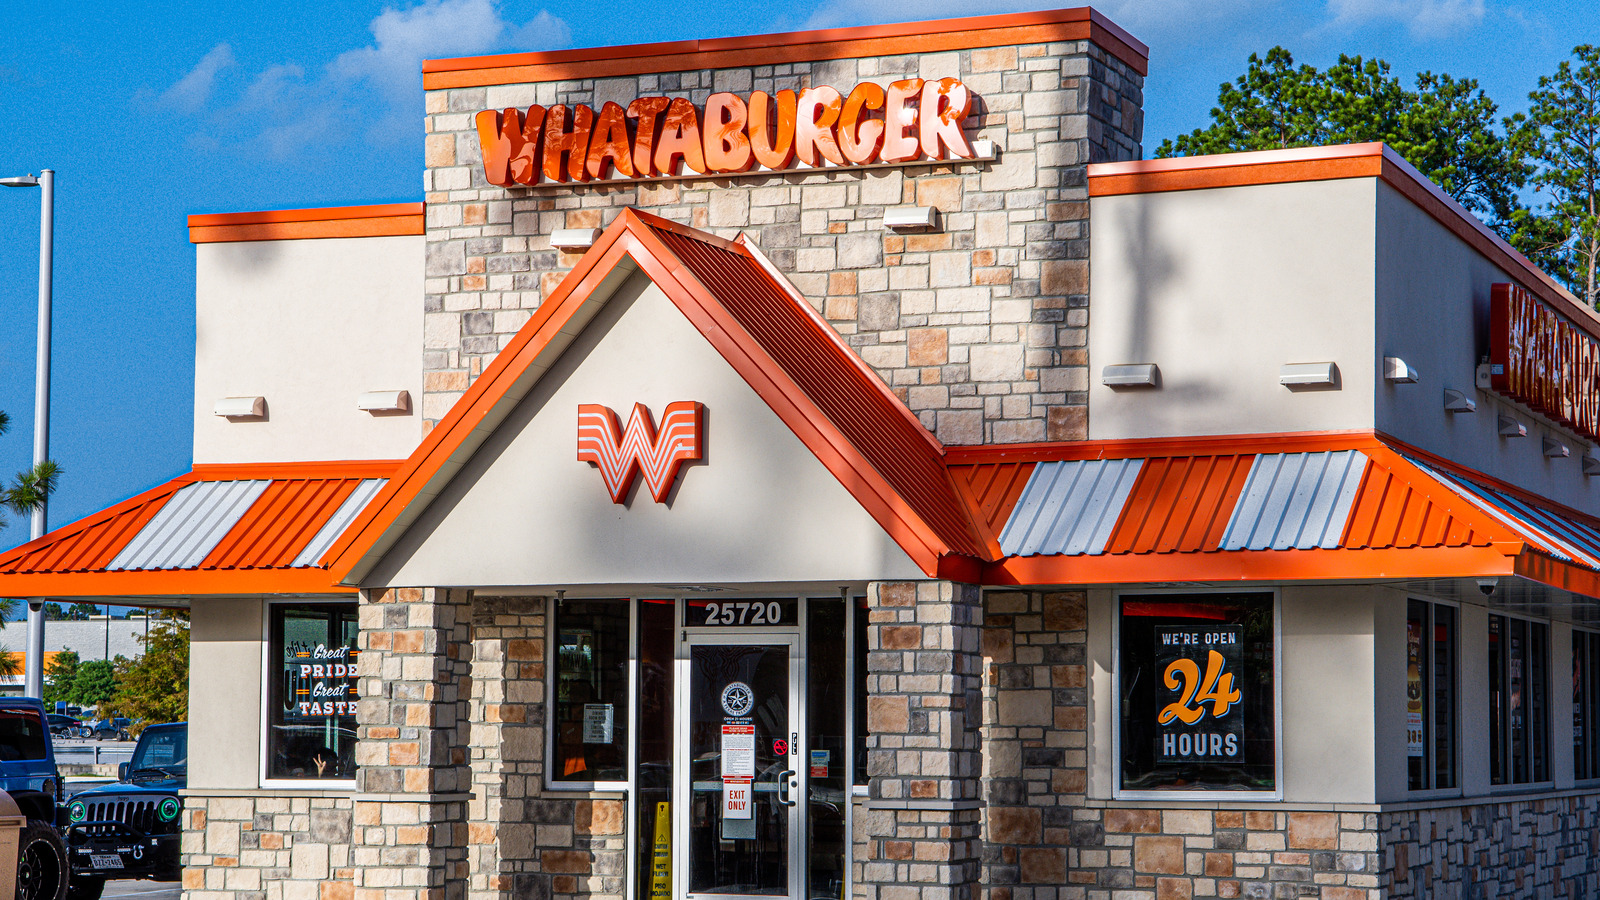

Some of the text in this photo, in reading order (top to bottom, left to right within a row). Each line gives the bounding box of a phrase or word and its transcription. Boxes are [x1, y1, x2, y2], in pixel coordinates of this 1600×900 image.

[475, 77, 975, 188] WHATABURGER
[705, 602, 781, 625] 25720
[1161, 632, 1236, 645] WE'RE OPEN
[314, 643, 350, 658] Great
[300, 664, 358, 678] PRIDE
[313, 682, 350, 696] Great
[1157, 649, 1242, 726] 24
[299, 702, 358, 716] TASTE
[1163, 733, 1238, 756] HOURS
[729, 790, 745, 800] EXIT
[728, 800, 746, 810] ONLY
